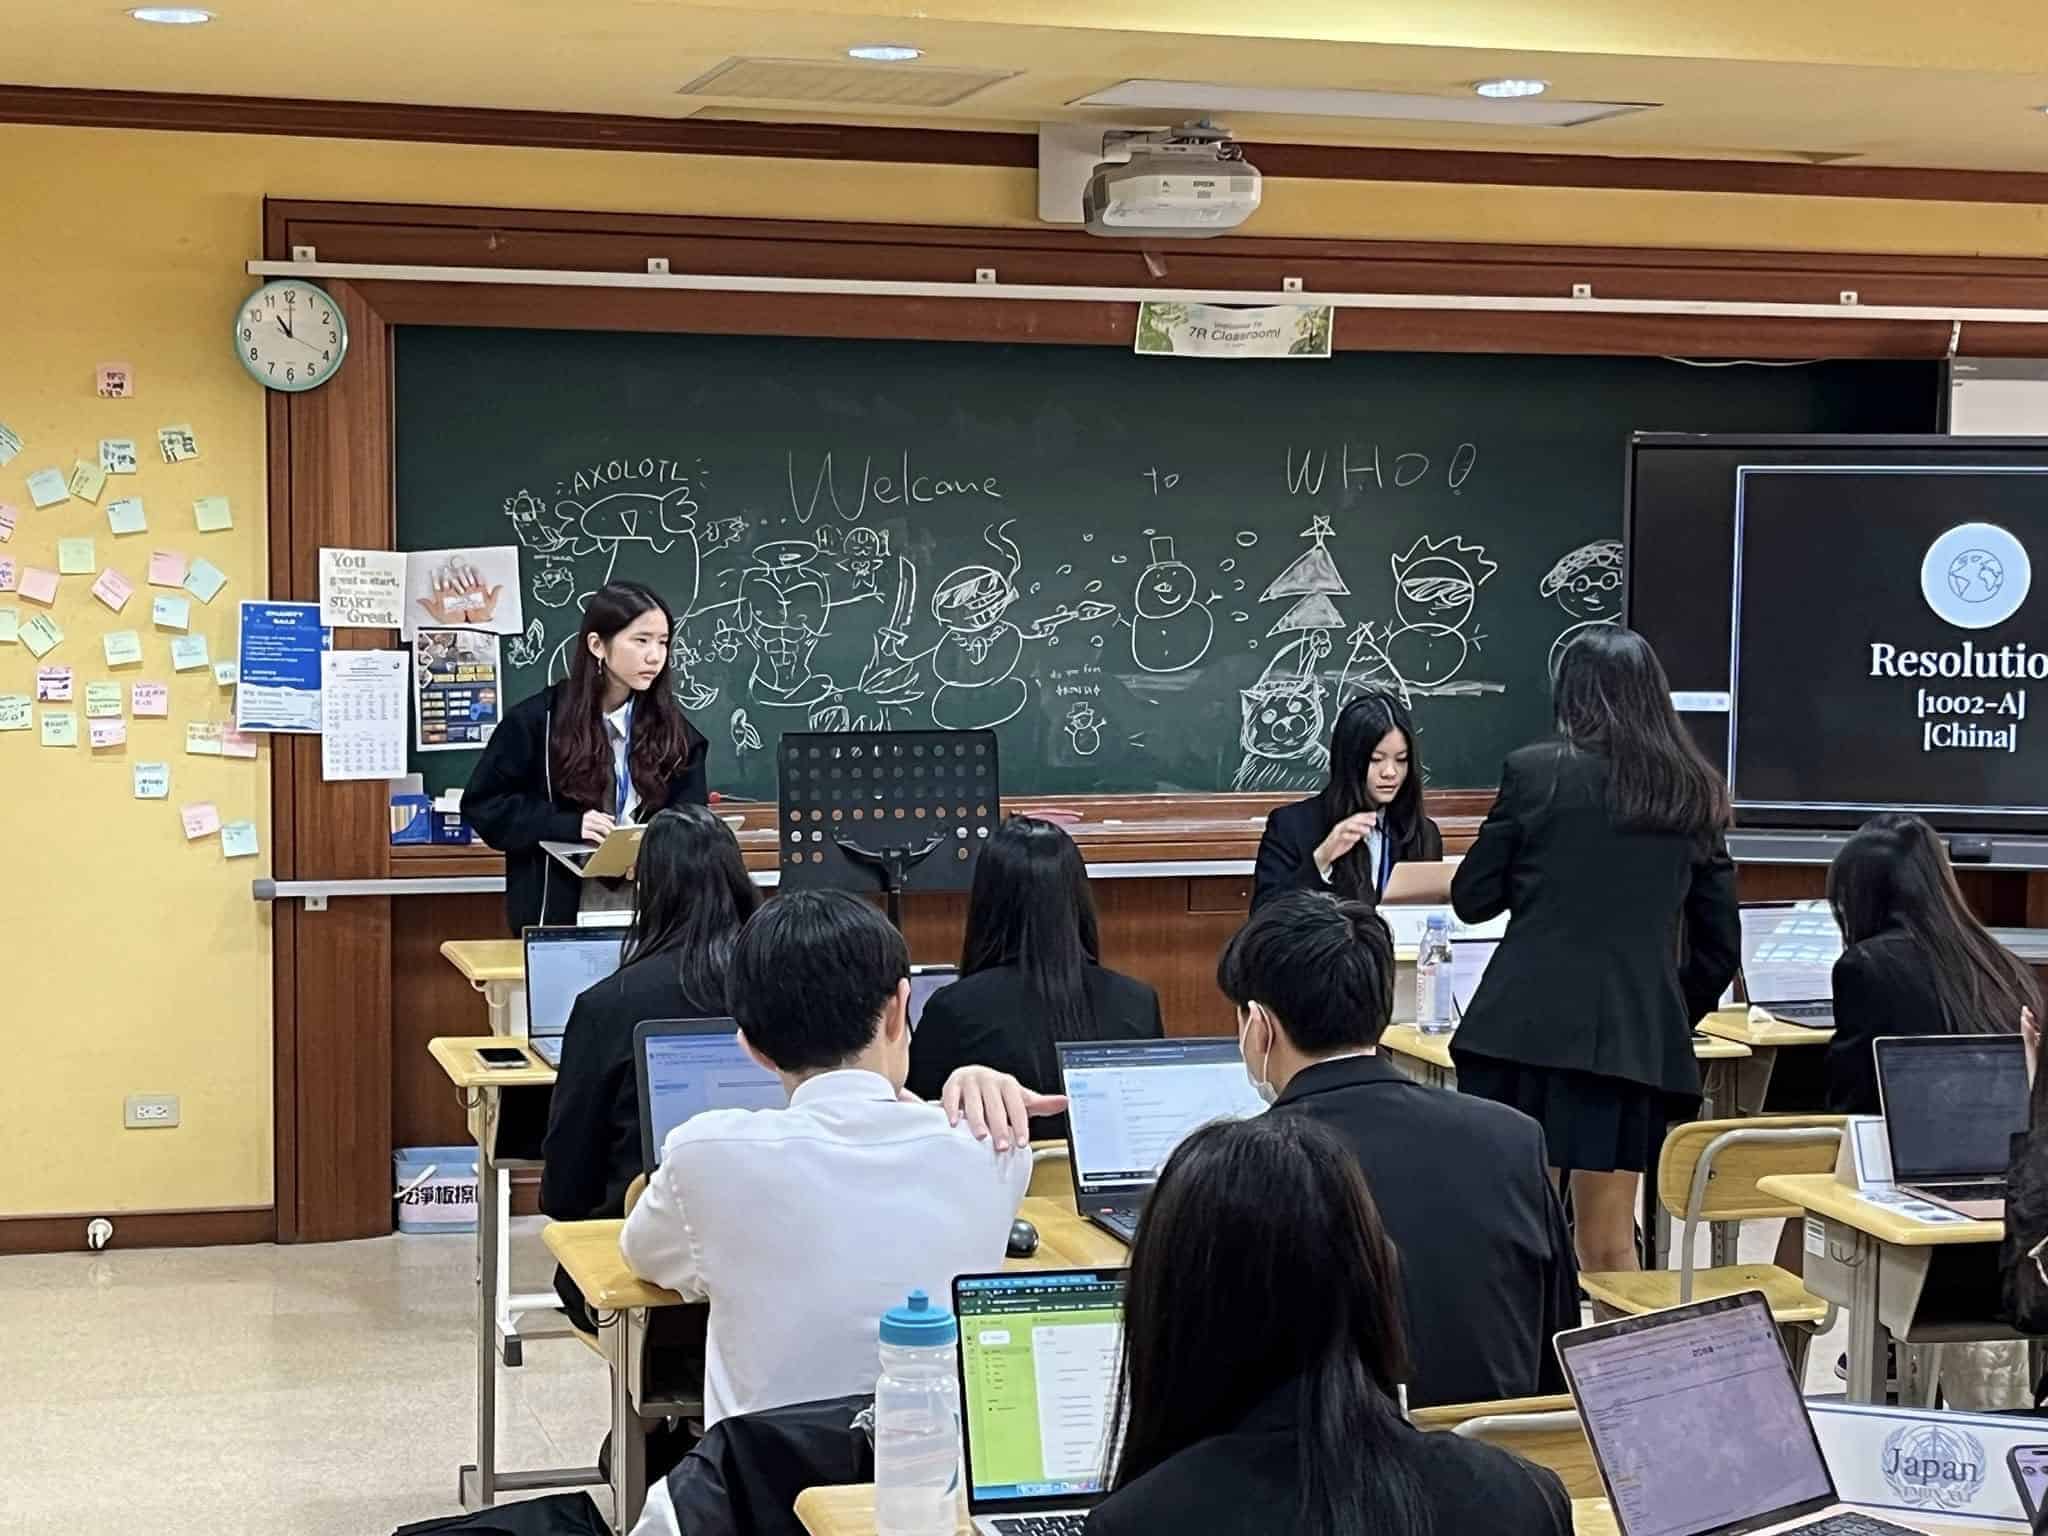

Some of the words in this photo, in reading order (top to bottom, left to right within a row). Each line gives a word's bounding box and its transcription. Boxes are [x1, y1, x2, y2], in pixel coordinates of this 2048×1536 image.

[264, 295, 275, 309] 11
[284, 290, 296, 304] 12
[308, 296, 314, 309] 1
[250, 309, 262, 322] 10
[322, 311, 330, 325] 2
[243, 328, 252, 342] 9
[329, 331, 337, 344] 3
[1189, 325, 1208, 340] 7R
[250, 347, 258, 361] 8
[322, 350, 330, 363] 4
[267, 361, 276, 375] 7
[286, 367, 295, 382] 6
[307, 362, 316, 376] 5
[574, 457, 689, 497] AXOLOTL
[1143, 466, 1180, 497] to
[329, 551, 367, 569] You
[329, 596, 375, 609] START
[1918, 688, 2026, 721] [1002-A]
[1923, 721, 2017, 753] [China]
[1887, 1447, 1977, 1487] Japan
